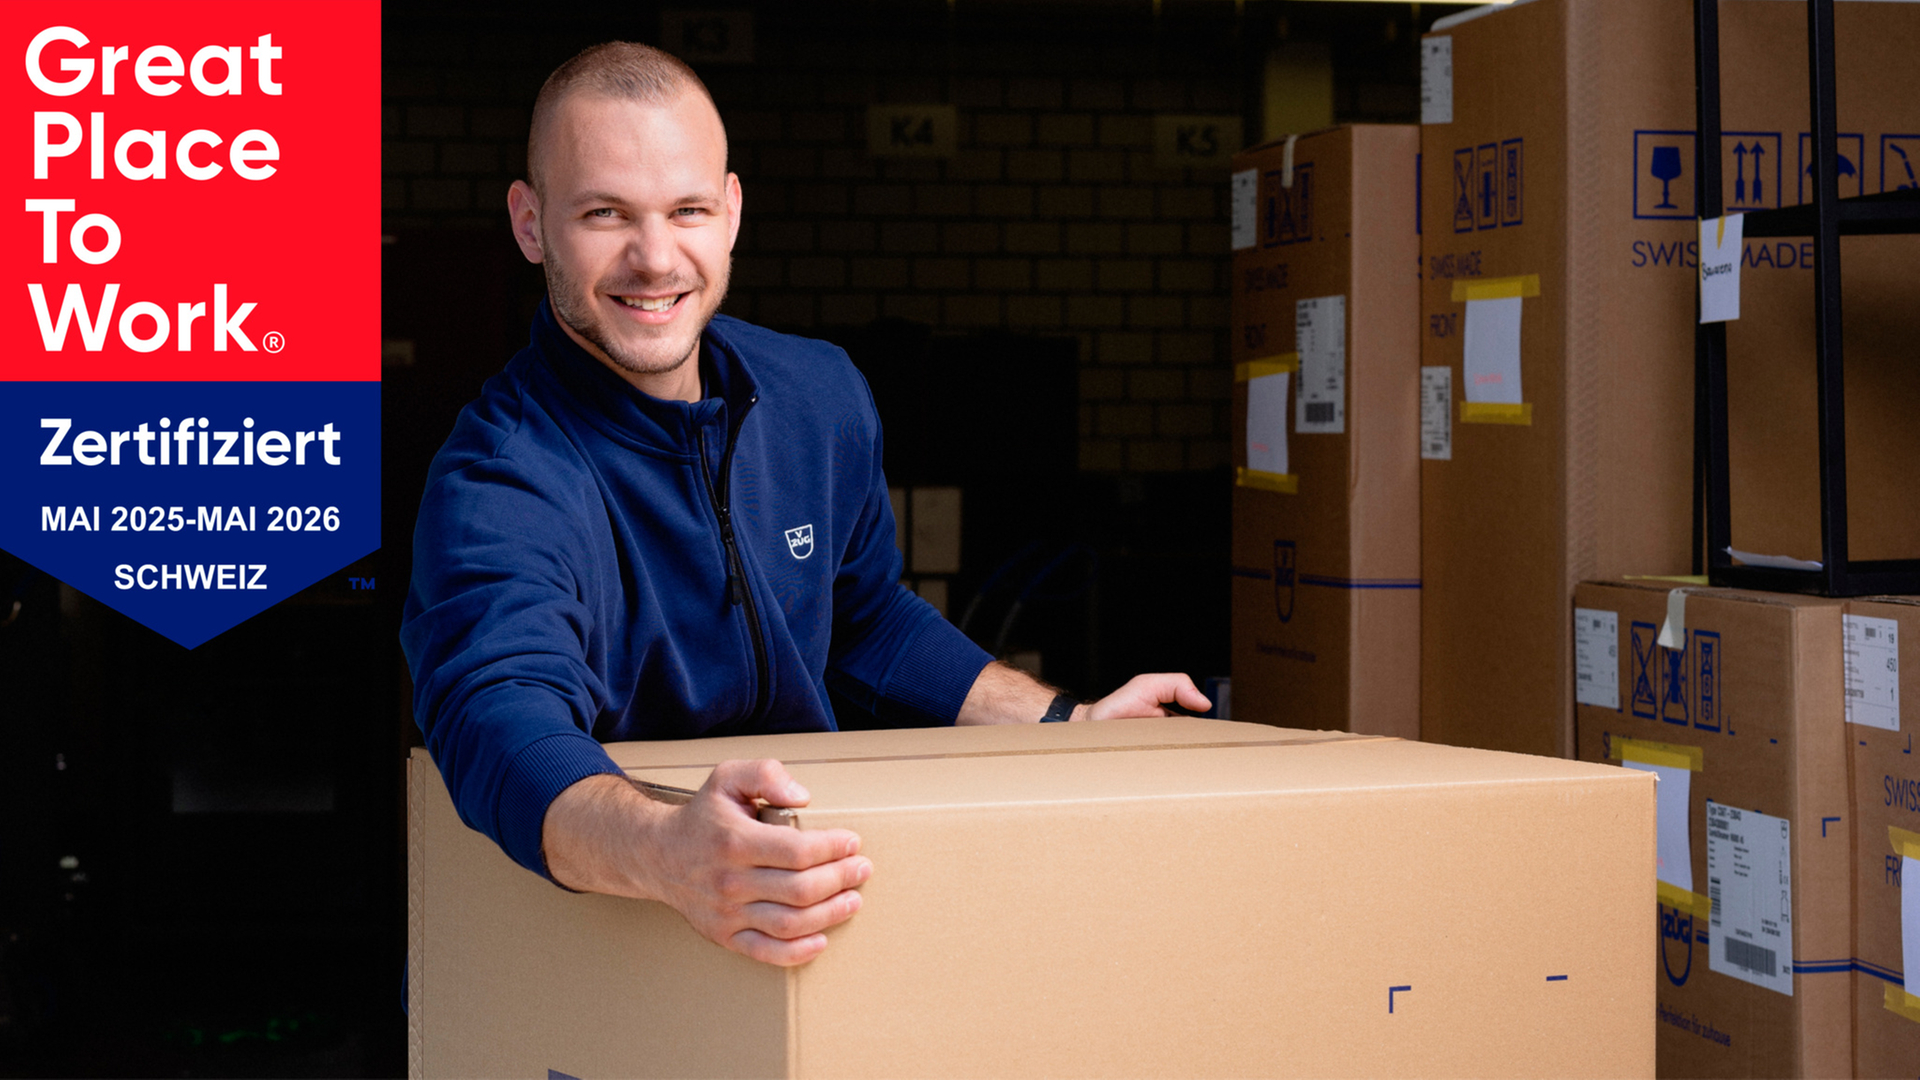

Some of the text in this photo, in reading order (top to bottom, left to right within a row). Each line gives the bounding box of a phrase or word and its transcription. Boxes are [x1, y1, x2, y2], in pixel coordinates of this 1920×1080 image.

[890, 116, 934, 147] K4
[1175, 124, 1218, 157] K5
[1632, 241, 1698, 268] SWIS
[791, 535, 811, 548] ZUG
